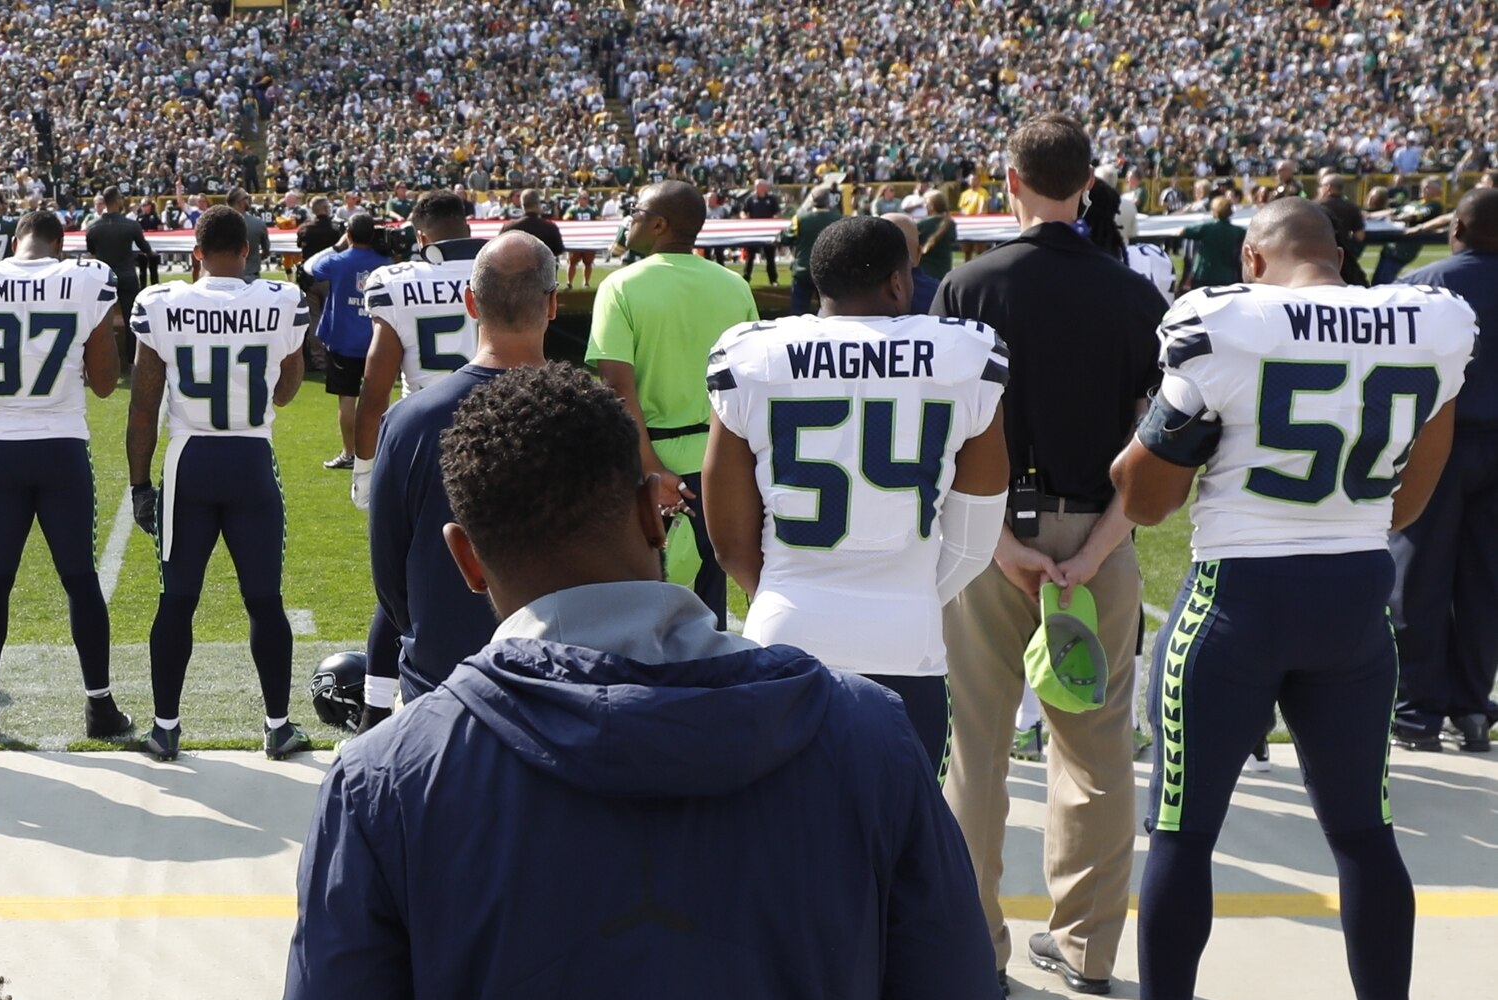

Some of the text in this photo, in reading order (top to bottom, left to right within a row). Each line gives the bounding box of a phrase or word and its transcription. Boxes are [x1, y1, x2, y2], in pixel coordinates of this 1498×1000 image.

[60, 277, 72, 300] II
[403, 280, 471, 306] ALEX
[1283, 303, 1421, 345] WRIGHT
[786, 340, 934, 379] WAGNER
[175, 345, 268, 431] 41
[1241, 358, 1443, 507] 50
[768, 397, 955, 551] 54
